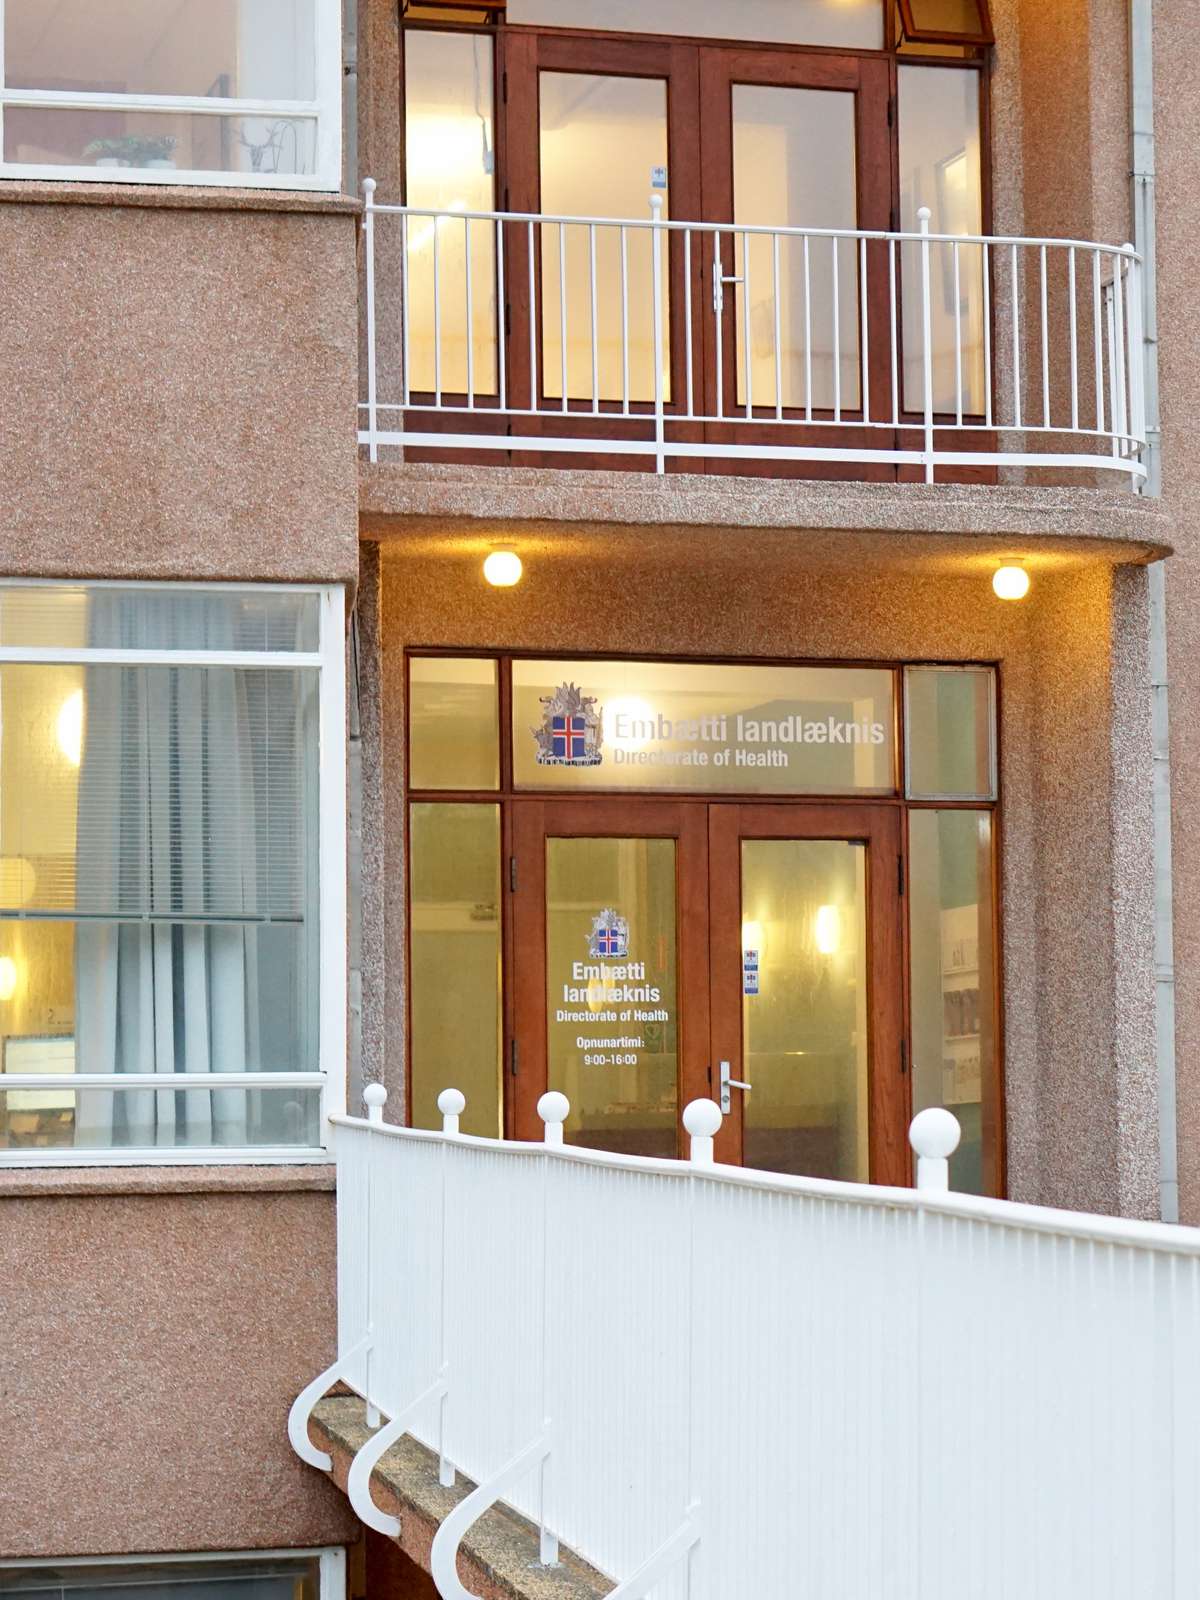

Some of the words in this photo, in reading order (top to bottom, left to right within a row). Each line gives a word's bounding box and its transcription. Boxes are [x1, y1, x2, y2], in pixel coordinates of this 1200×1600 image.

[614, 712, 727, 742] Embætti
[736, 714, 885, 744] landlæknis
[614, 748, 708, 767] Directorate
[713, 749, 730, 767] of
[735, 749, 788, 767] Health
[572, 962, 645, 980] Embætti
[563, 984, 661, 1003] landlæknis
[556, 1010, 617, 1022] Directorate
[620, 1010, 631, 1022] of
[634, 1010, 669, 1022] Health
